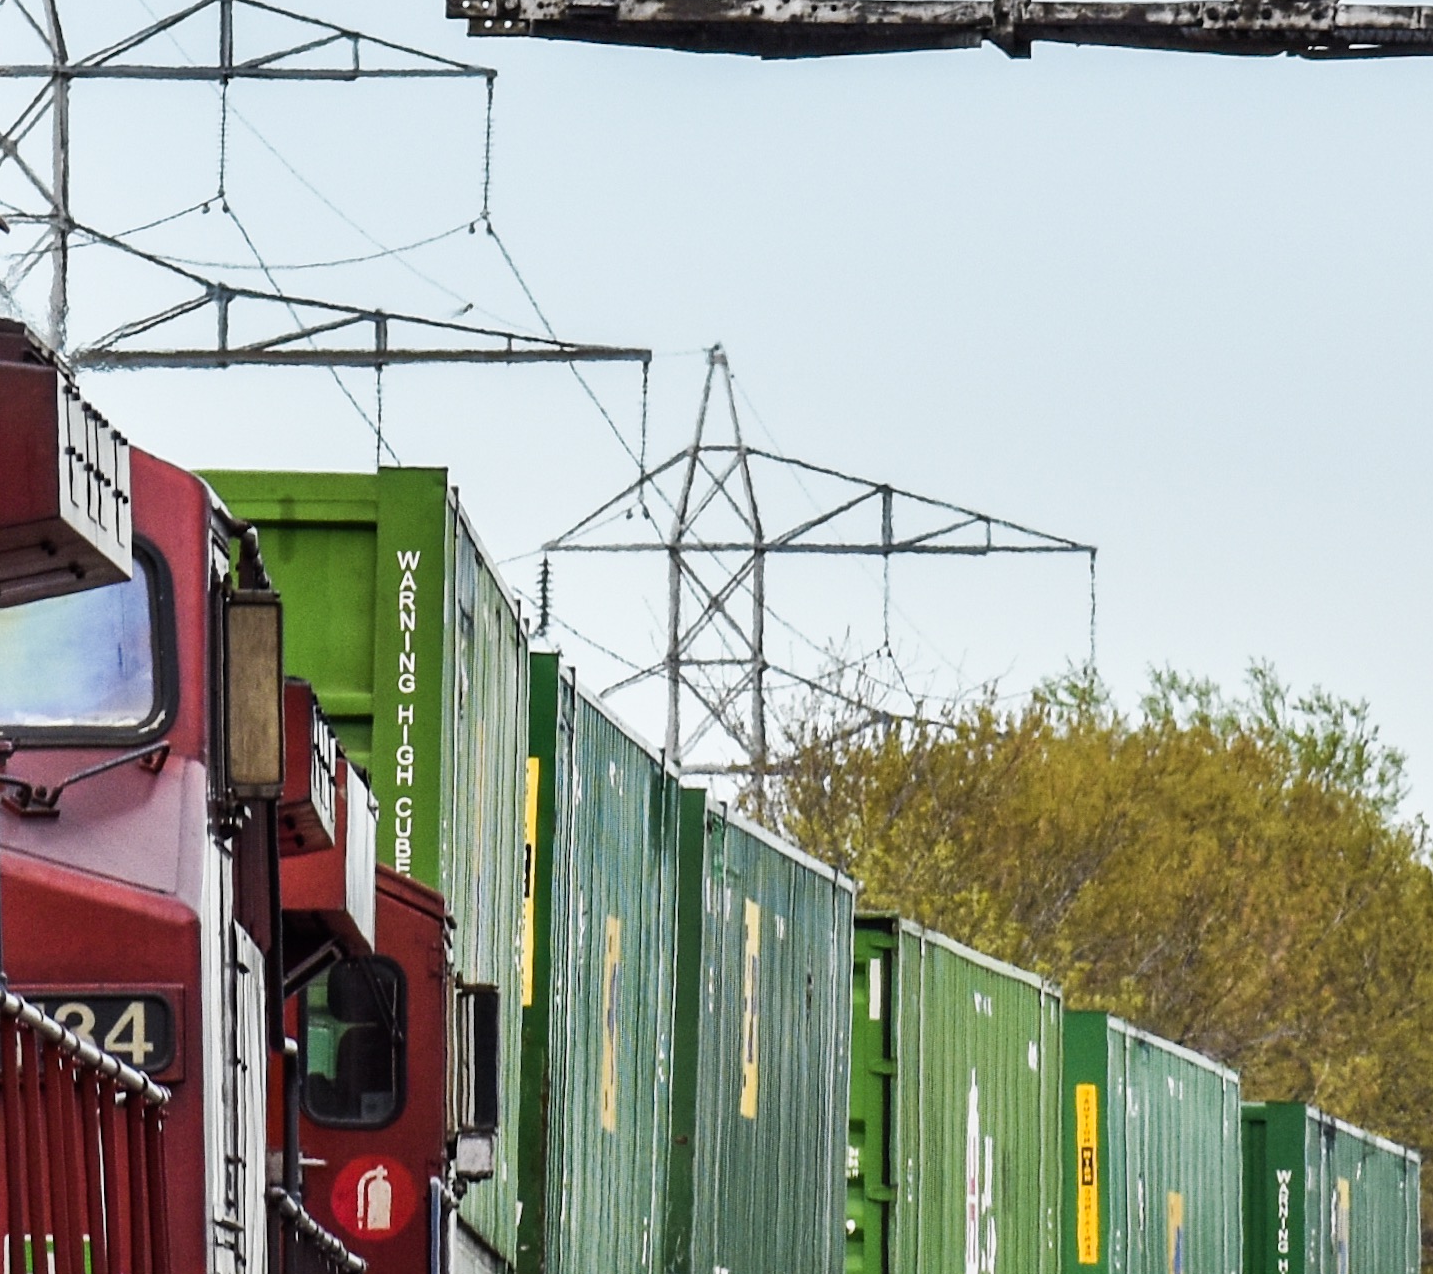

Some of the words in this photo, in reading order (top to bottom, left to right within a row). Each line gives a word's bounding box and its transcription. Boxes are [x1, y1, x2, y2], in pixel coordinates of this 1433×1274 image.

[396, 550, 421, 694] WARNING
[396, 703, 414, 787] HIGH
[394, 796, 413, 879] CUBE
[1276, 1169, 1292, 1255] WARNING
